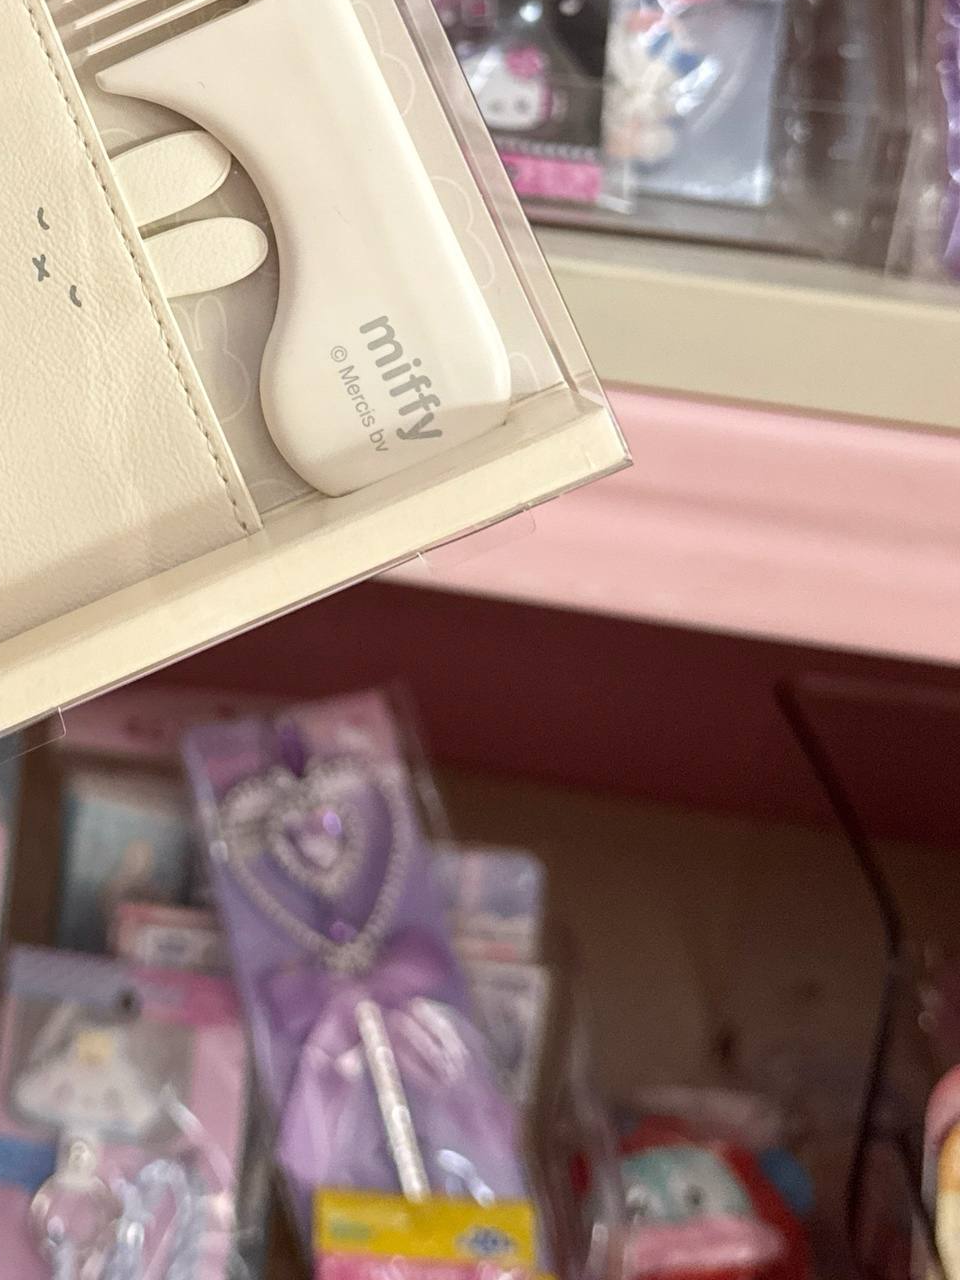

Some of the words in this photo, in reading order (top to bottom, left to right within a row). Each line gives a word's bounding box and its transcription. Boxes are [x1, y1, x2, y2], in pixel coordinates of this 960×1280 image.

[338, 365, 376, 428] Mercis
[369, 428, 389, 452] bv
[359, 315, 443, 441] miffy
